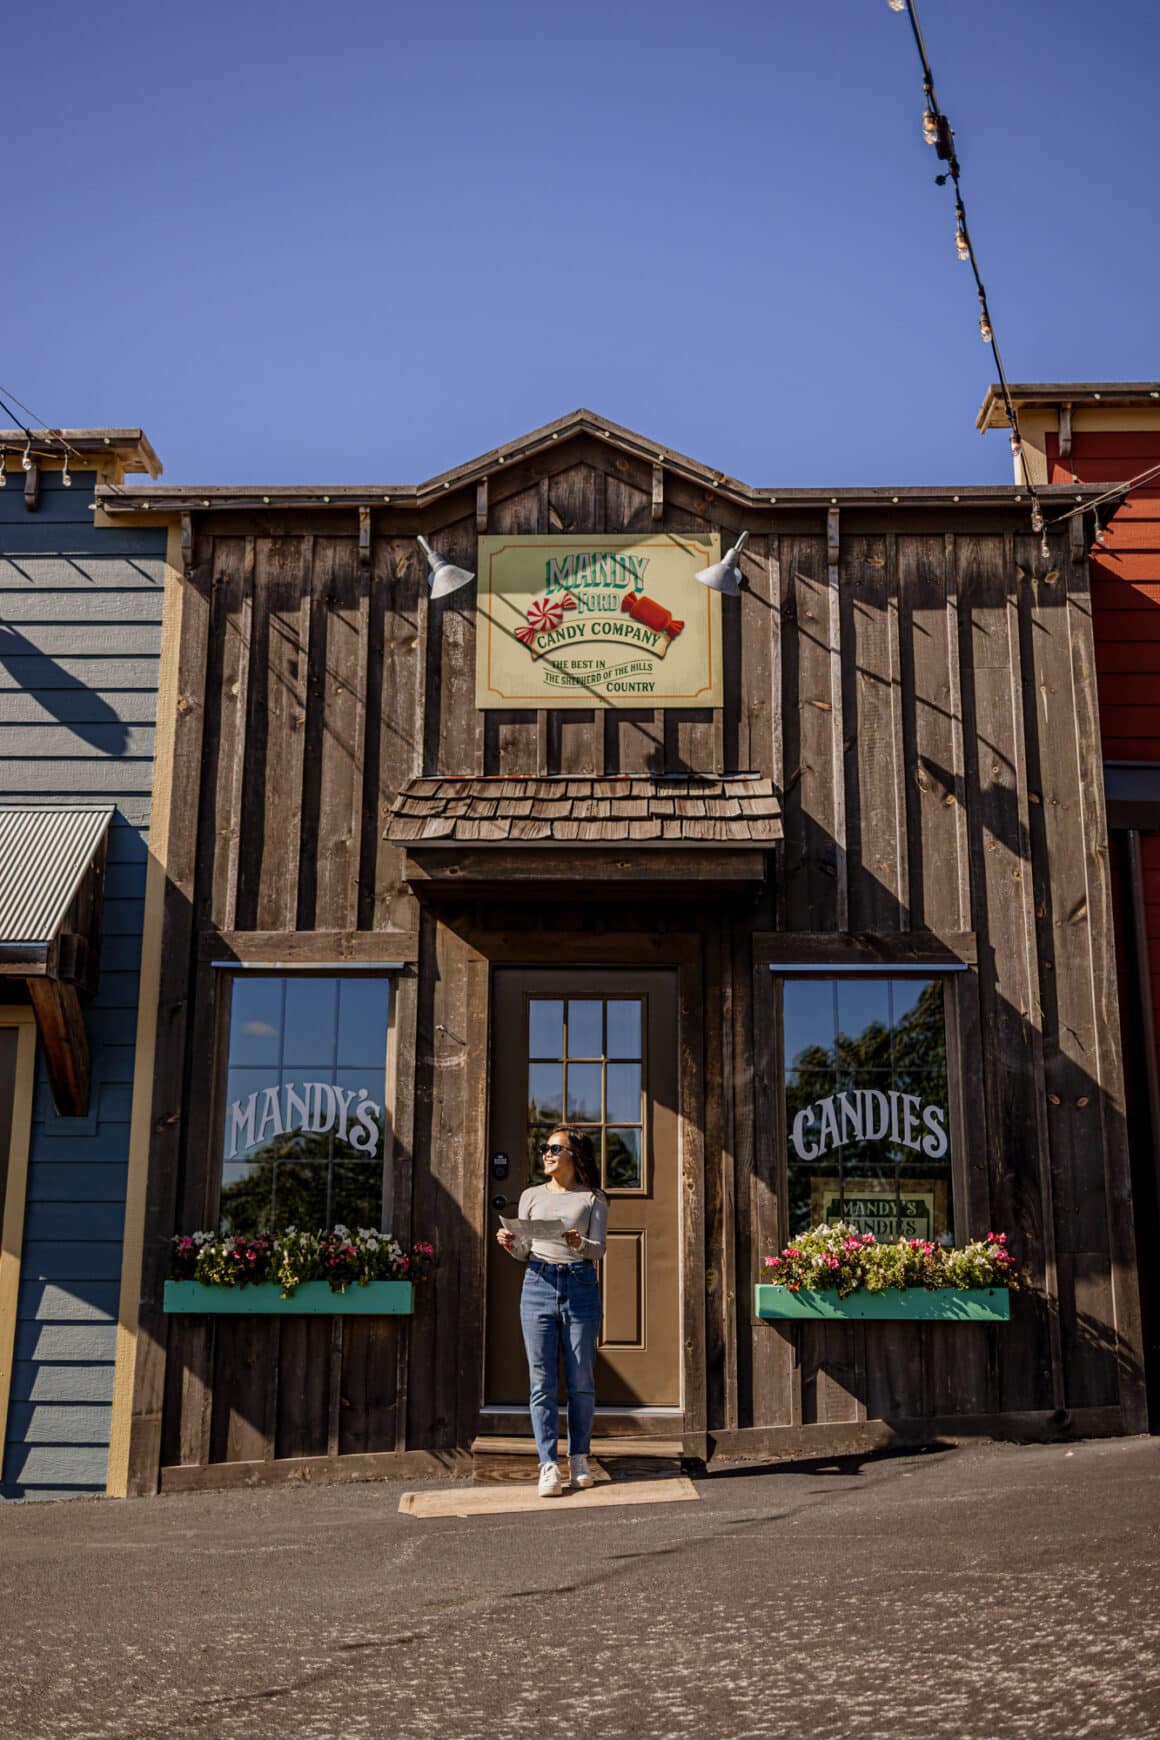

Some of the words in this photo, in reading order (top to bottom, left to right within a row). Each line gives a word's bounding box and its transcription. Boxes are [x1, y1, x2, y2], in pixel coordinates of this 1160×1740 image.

[545, 552, 650, 594] MANDY
[577, 592, 621, 614] FORD
[537, 624, 586, 649] CANDY
[591, 622, 661, 647] COMPANY
[545, 672, 560, 684] THE
[561, 673, 602, 686] SHEPHERD
[603, 670, 612, 680] OF
[614, 667, 628, 677] THE
[630, 663, 653, 672] HILLS
[552, 660, 568, 669] THE
[571, 660, 593, 669] BEST
[596, 660, 606, 669] IN
[606, 682, 656, 692] COUNTRY
[229, 1082, 381, 1159] MANDY'S
[789, 1089, 948, 1161] CANDIES
